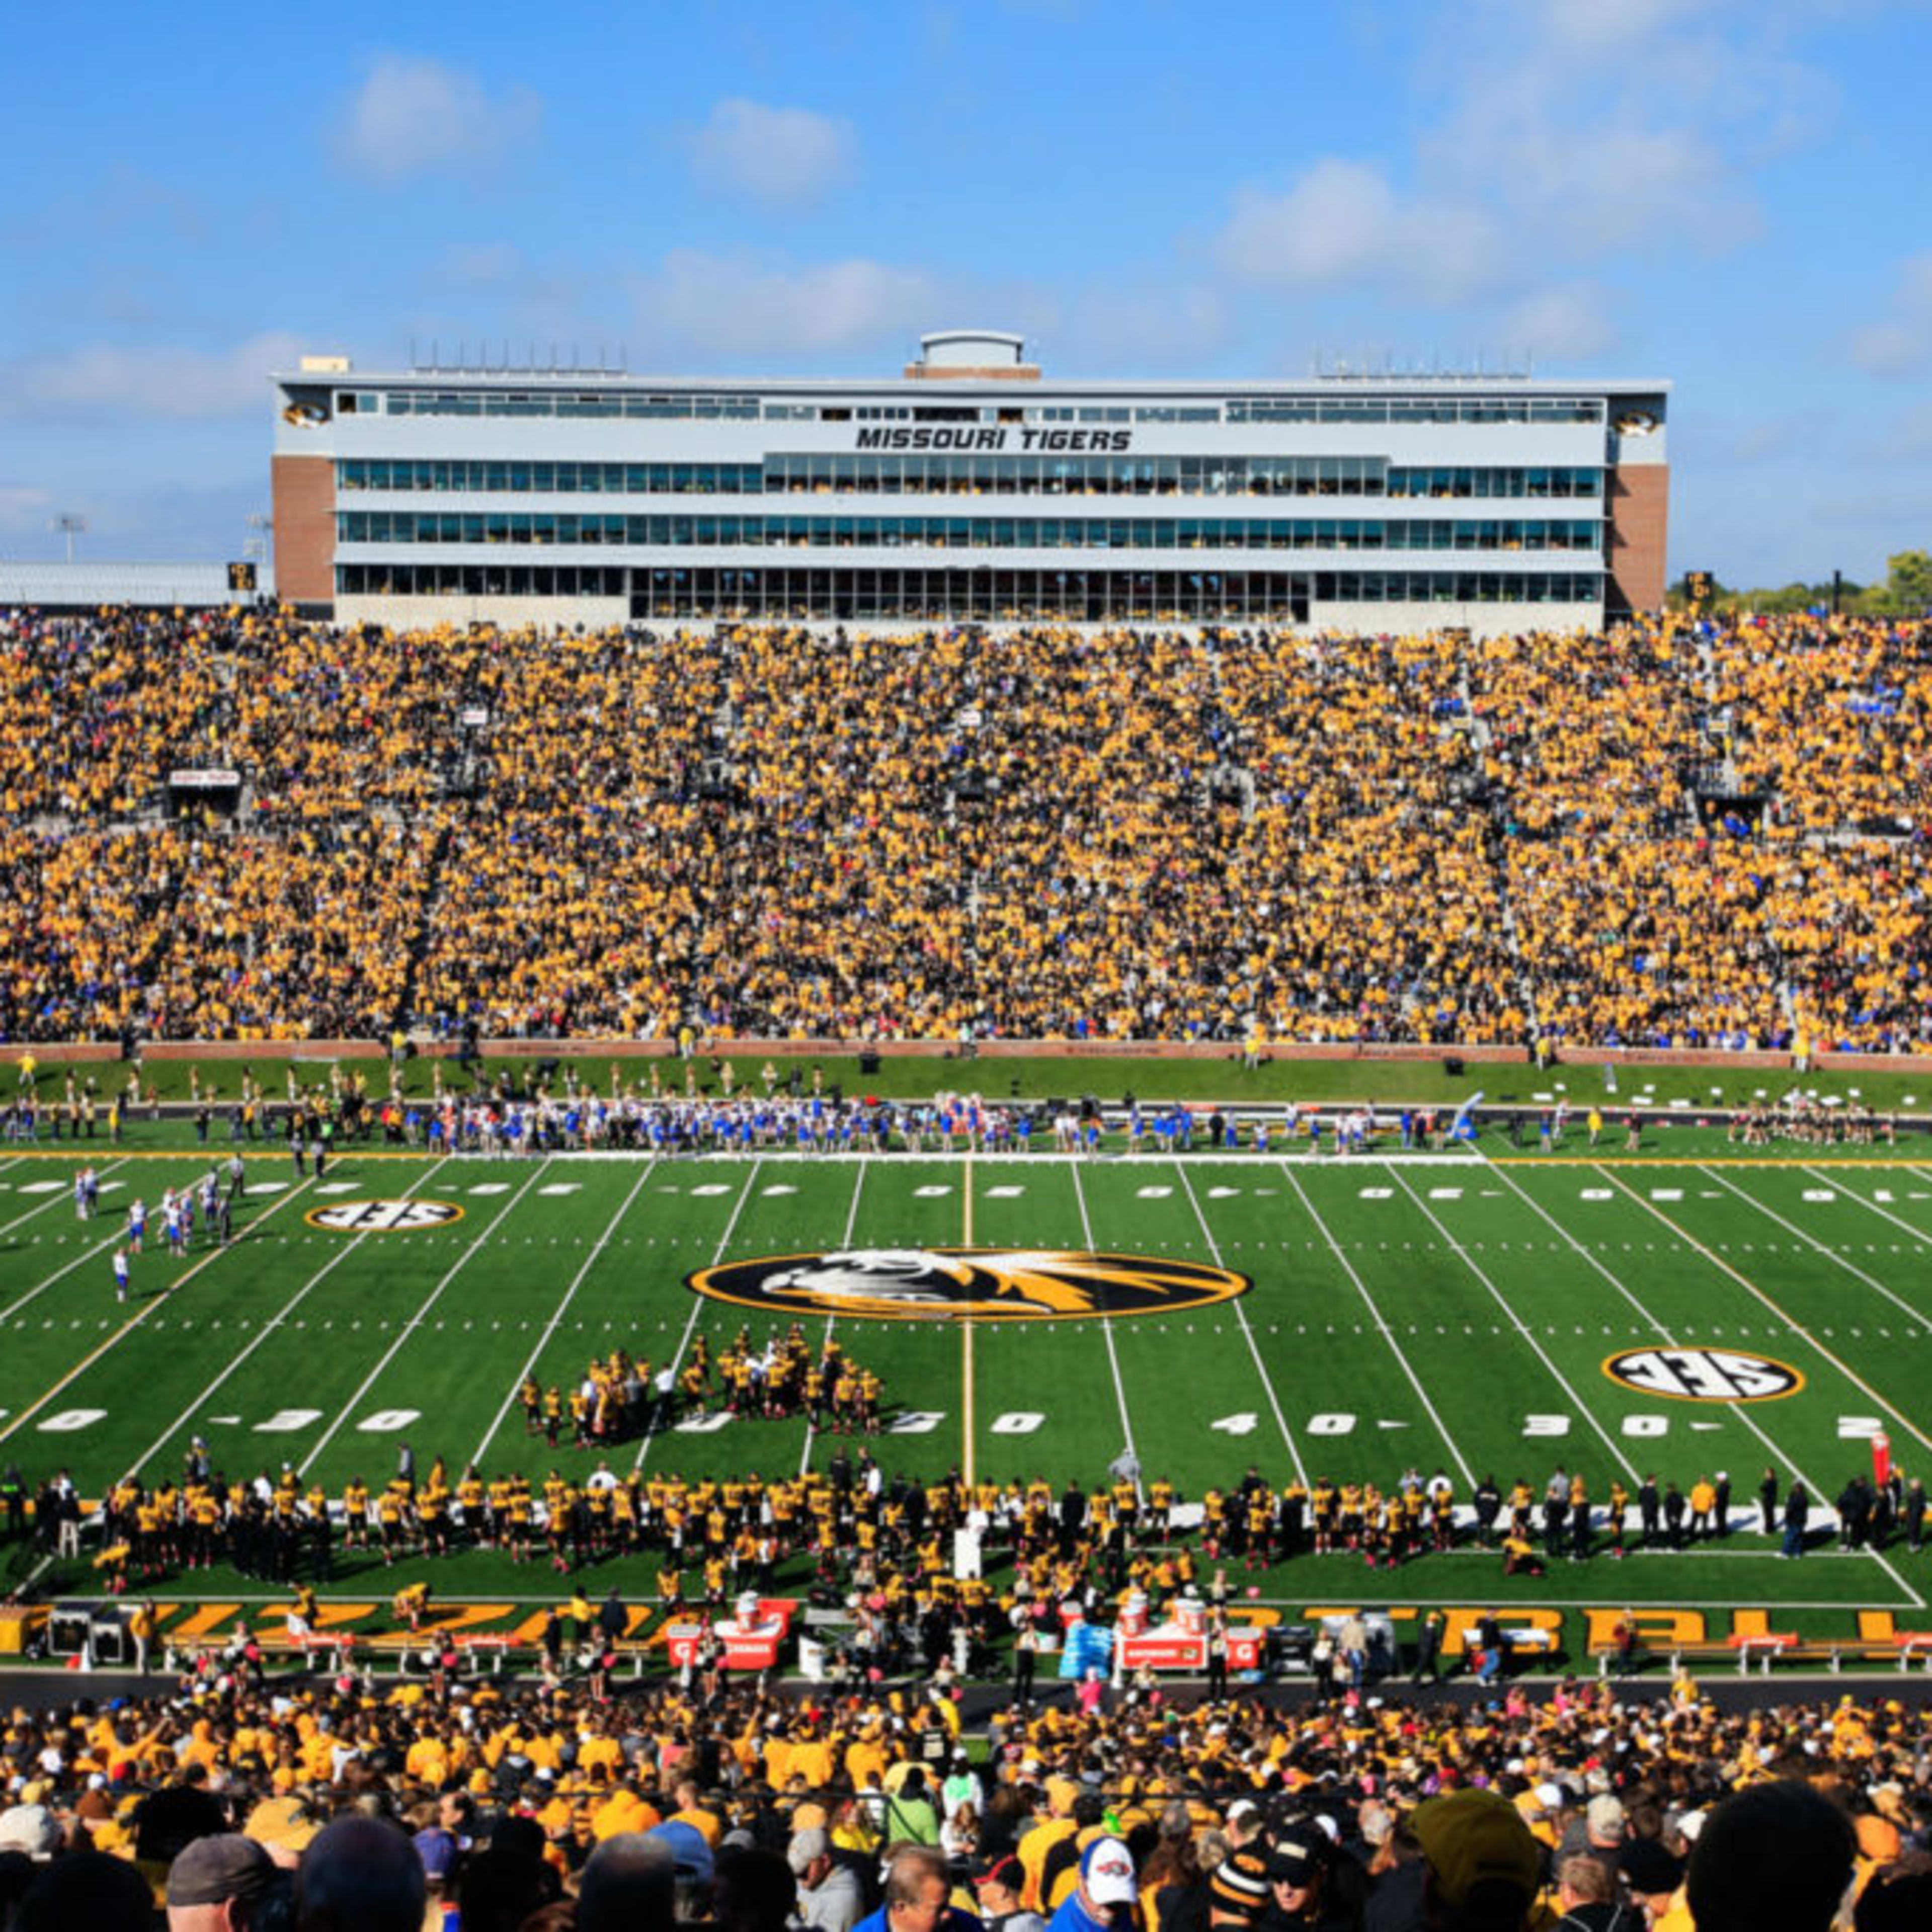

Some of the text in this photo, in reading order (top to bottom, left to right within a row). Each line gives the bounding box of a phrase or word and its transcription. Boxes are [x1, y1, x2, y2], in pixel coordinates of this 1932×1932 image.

[856, 428, 1132, 451] MISSOURI TIGERS
[1236, 1643, 1253, 1659] G
